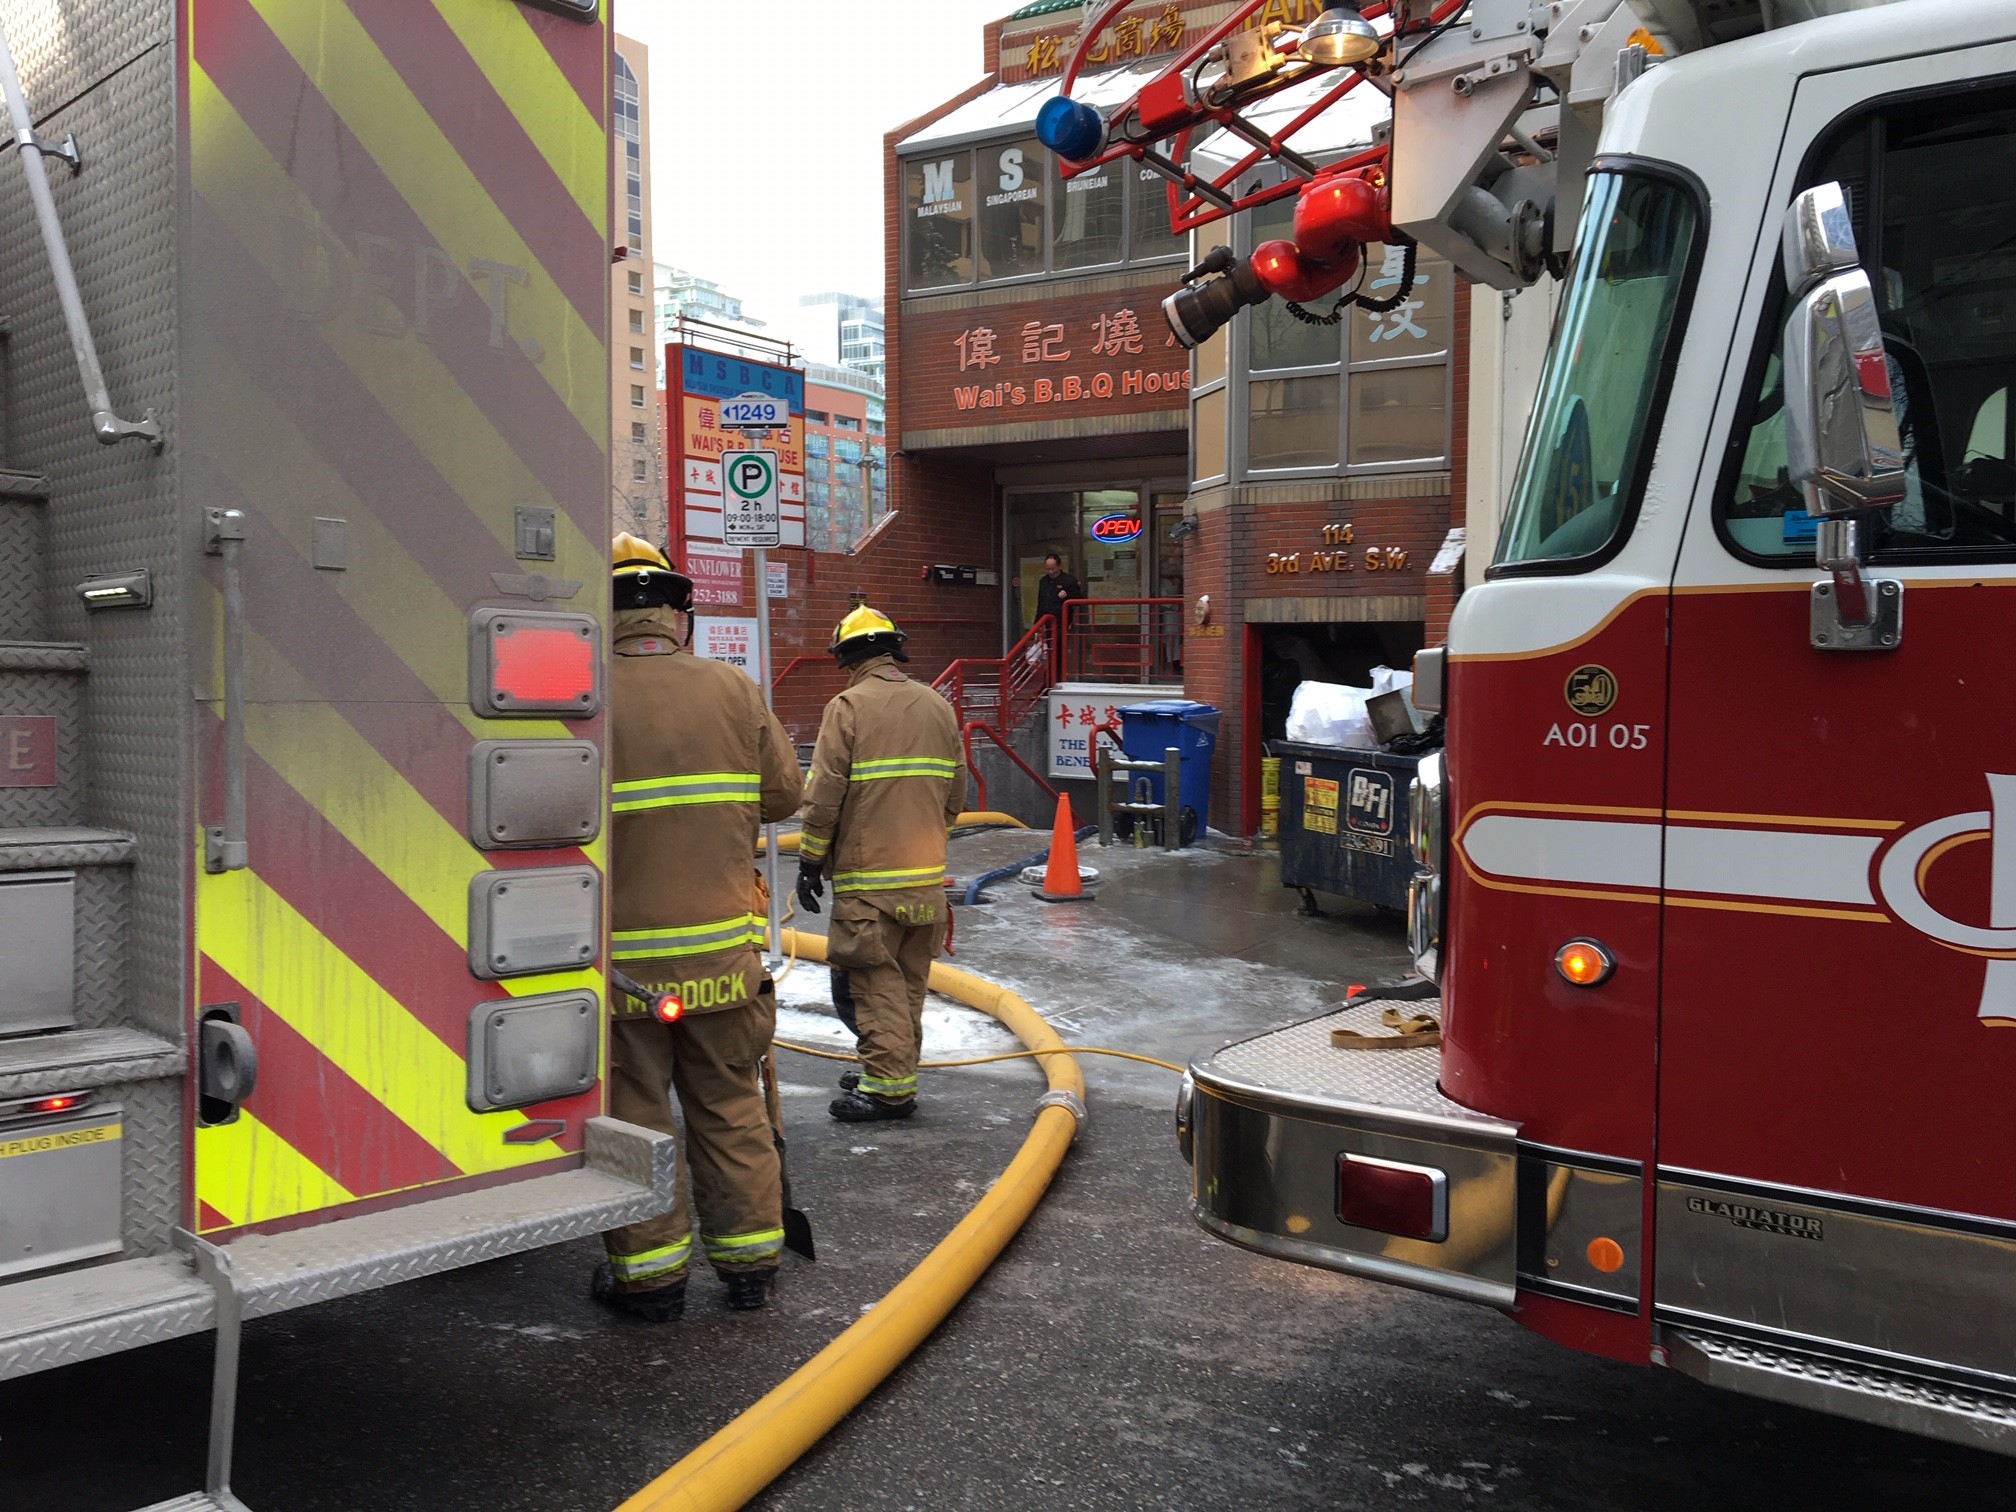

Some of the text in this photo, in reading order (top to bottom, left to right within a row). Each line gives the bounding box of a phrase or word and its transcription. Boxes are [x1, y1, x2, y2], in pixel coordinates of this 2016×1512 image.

[923, 148, 1024, 204] M S
[1066, 176, 1108, 193] BRUNEIAN
[986, 187, 1037, 207] SINGAPOREAN
[917, 200, 962, 217] MALAYSIAN
[279, 214, 546, 364] DEPT.
[954, 308, 1184, 372] 偉記燒
[689, 354, 795, 395] M S B C A
[954, 368, 1191, 410] Wai's B.B.Q Hous
[731, 404, 775, 421] 1249
[692, 434, 723, 452] WAI'S
[741, 463, 763, 490] P
[741, 500, 762, 511] 2 h
[727, 513, 777, 522] 09:00-18:00
[1094, 519, 1141, 536] OPEN
[1322, 524, 1354, 545] 114
[687, 558, 742, 577] SUNFLOWER
[1266, 553, 1300, 574] 3rd
[1365, 547, 1412, 571] S.W.
[692, 588, 738, 604] 252-3188
[1060, 739, 1087, 751] THE
[1542, 722, 1651, 749] A01 05
[1056, 756, 1090, 767] BENE
[1351, 775, 1389, 819] BFI
[9, 1137, 51, 1152] PLUG
[54, 1128, 105, 1146] INSIDE
[1688, 1197, 1823, 1232] GLADIATOR
[1731, 1218, 1824, 1241] CLASSIC
